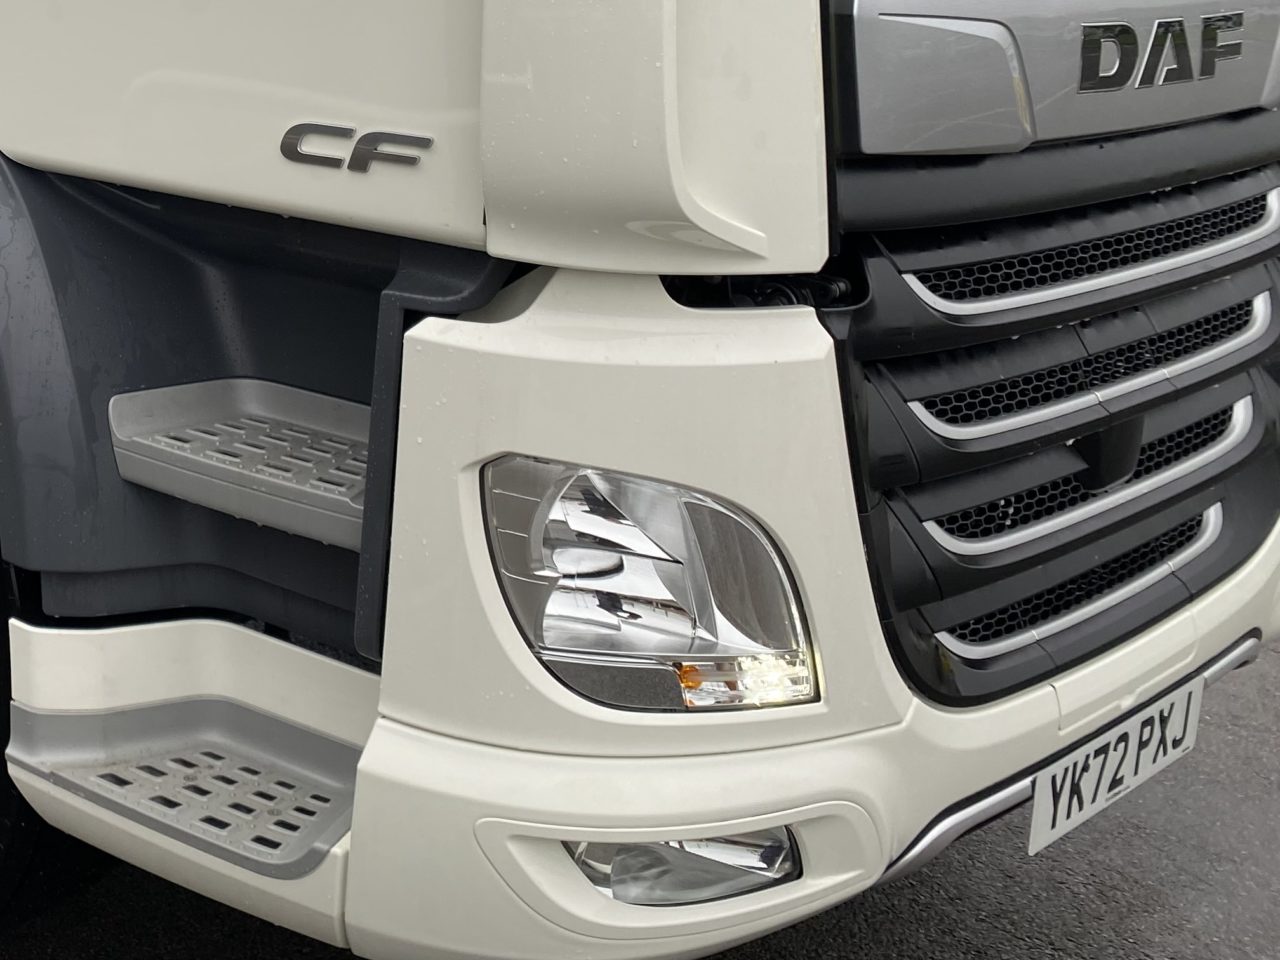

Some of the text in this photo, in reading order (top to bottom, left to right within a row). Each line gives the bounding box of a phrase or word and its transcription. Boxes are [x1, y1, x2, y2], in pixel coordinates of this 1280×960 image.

[1076, 10, 1245, 95] DAF
[280, 122, 435, 173] CF
[1050, 691, 1193, 831] YK72 PXJ
